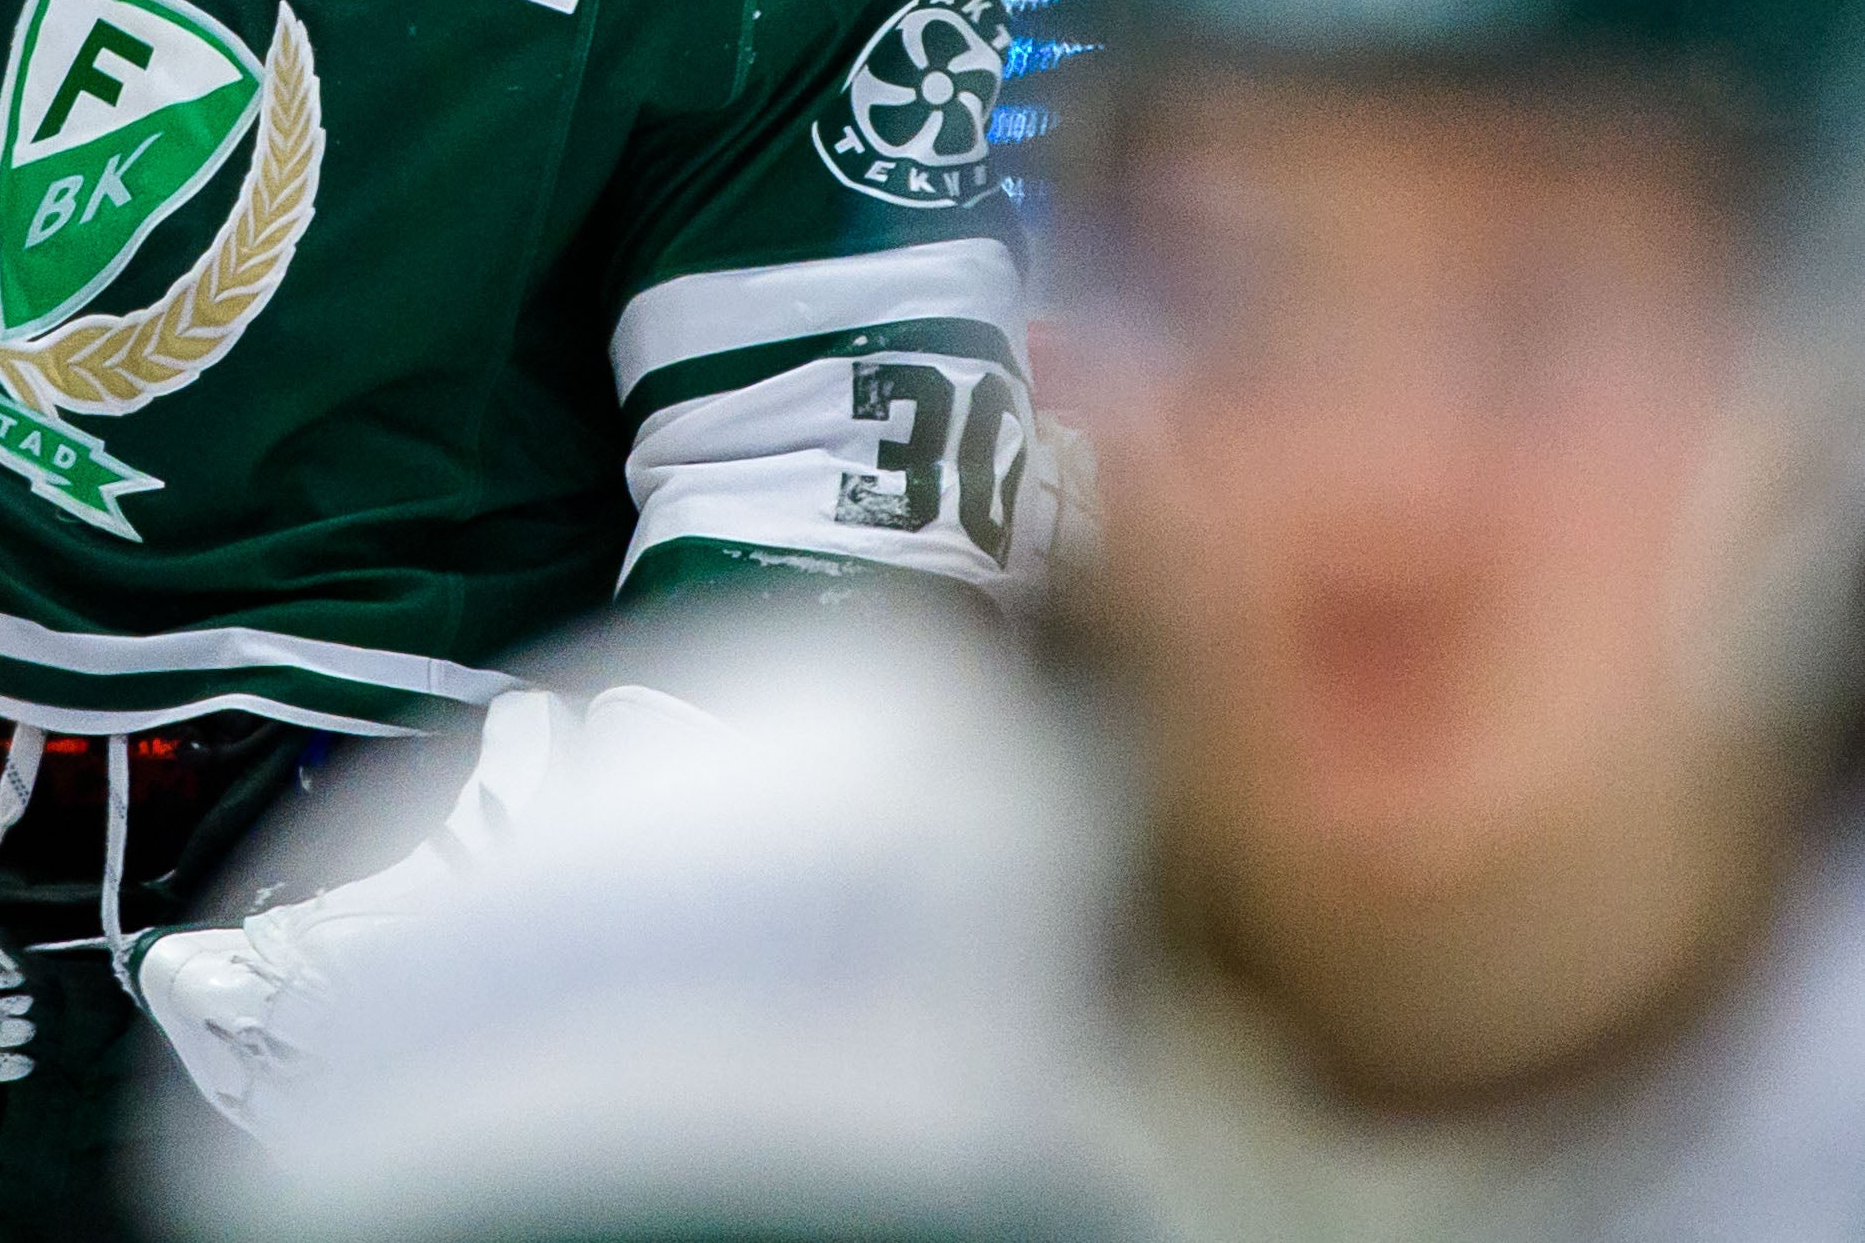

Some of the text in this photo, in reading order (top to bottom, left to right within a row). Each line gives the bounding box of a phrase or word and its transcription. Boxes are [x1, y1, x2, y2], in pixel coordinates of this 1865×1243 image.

[29, 17, 155, 145] F
[24, 132, 164, 249] BK
[833, 360, 1028, 572] 30
